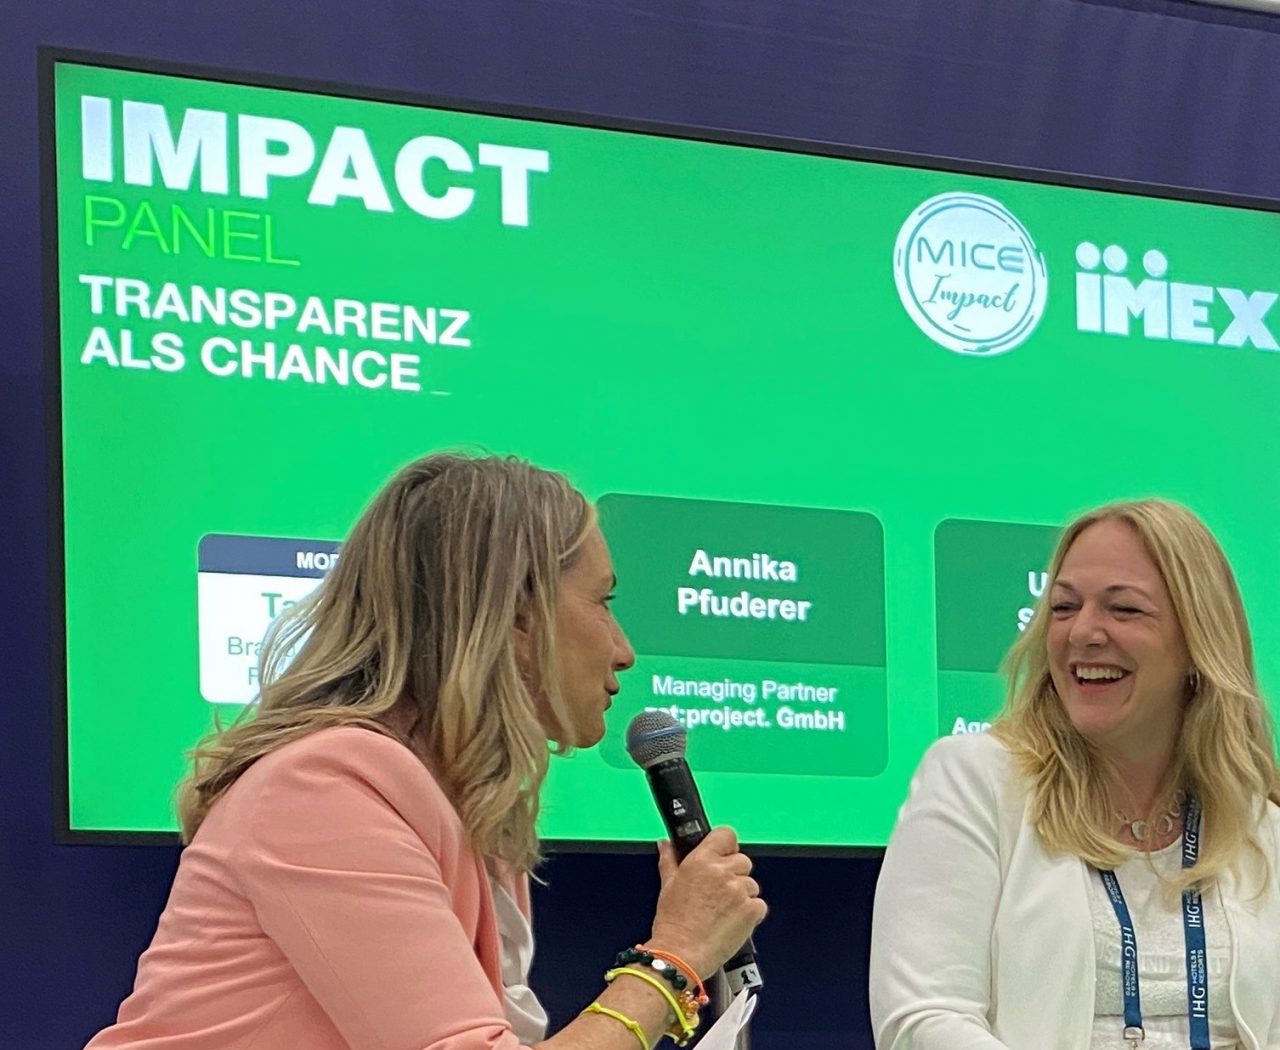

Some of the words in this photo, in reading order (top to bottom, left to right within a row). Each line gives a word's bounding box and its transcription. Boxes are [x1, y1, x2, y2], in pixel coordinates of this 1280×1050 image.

[80, 94, 549, 228] IMPACT
[84, 194, 301, 266] PANEL
[917, 237, 1025, 274] MICE
[78, 273, 471, 348] TRANSPARENZ
[921, 272, 1020, 321] Impact
[80, 326, 186, 373] ALS
[200, 336, 422, 392] CHANCE
[688, 549, 797, 582] Annika
[677, 587, 812, 622] Pfuderer
[652, 674, 757, 704] Managing
[761, 679, 837, 704] Partner
[776, 709, 845, 732] GmbH
[1184, 832, 1197, 861] IHG
[1187, 903, 1201, 928] IHG
[1121, 926, 1136, 958] IHG
[1192, 985, 1206, 1019] IHG
